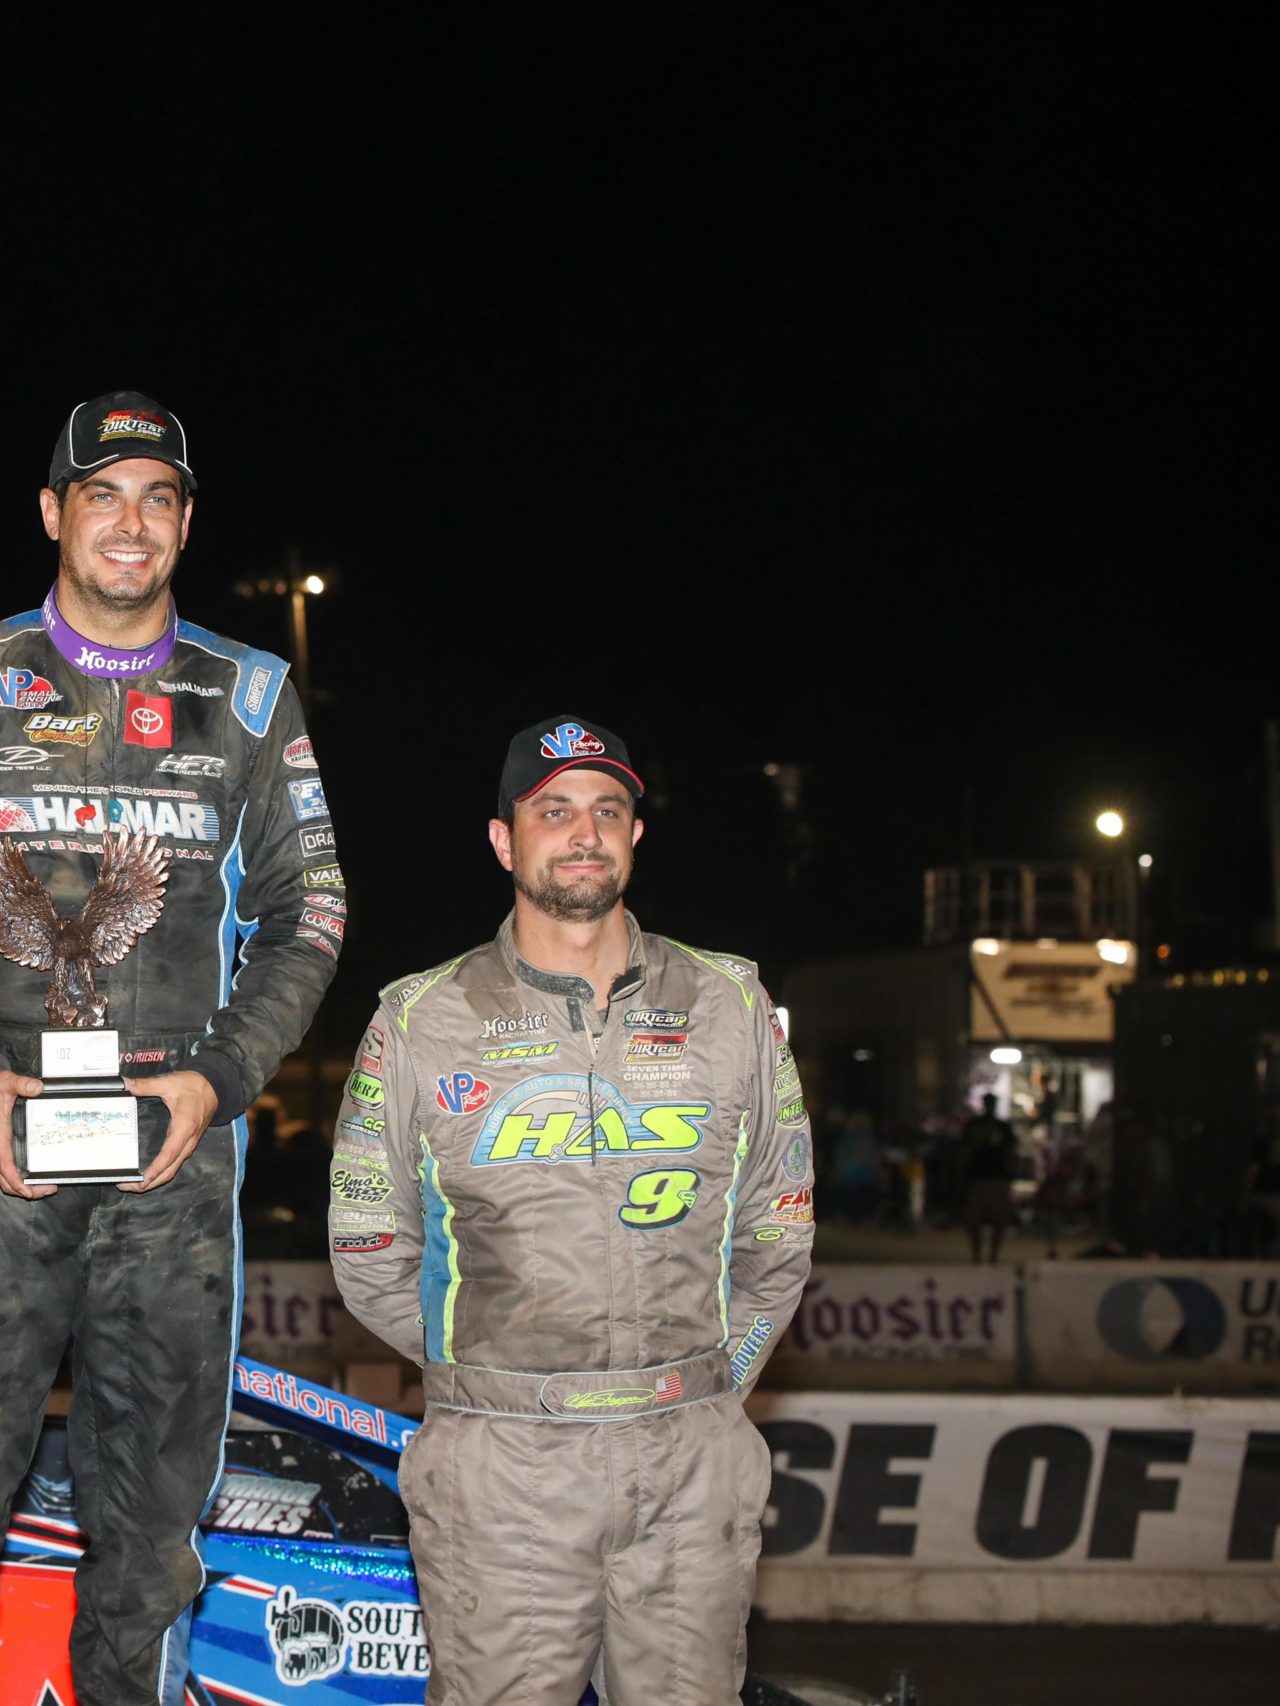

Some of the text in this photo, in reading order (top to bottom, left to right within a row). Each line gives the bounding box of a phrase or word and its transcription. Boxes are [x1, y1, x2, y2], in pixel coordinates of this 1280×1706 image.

[74, 646, 155, 672] Hoosier
[248, 669, 270, 712] SIMPSON
[26, 714, 100, 731] Bart
[540, 723, 585, 757] VP
[143, 788, 199, 800] FORWARD
[304, 831, 335, 850] DRA
[480, 1011, 549, 1039] Hoosier
[481, 1042, 559, 1061] MSM
[623, 1070, 691, 1082] CHAMPION
[626, 1064, 688, 1072] SEVEN TIME
[350, 1079, 383, 1099] BERT
[437, 1072, 476, 1114] VP
[524, 1077, 554, 1094] AUTO
[487, 1106, 709, 1160] HAS
[331, 1167, 386, 1188] Elmo's
[619, 1167, 701, 1231] 9
[729, 1315, 775, 1385] MOVERS
[975, 1423, 1195, 1562] OF
